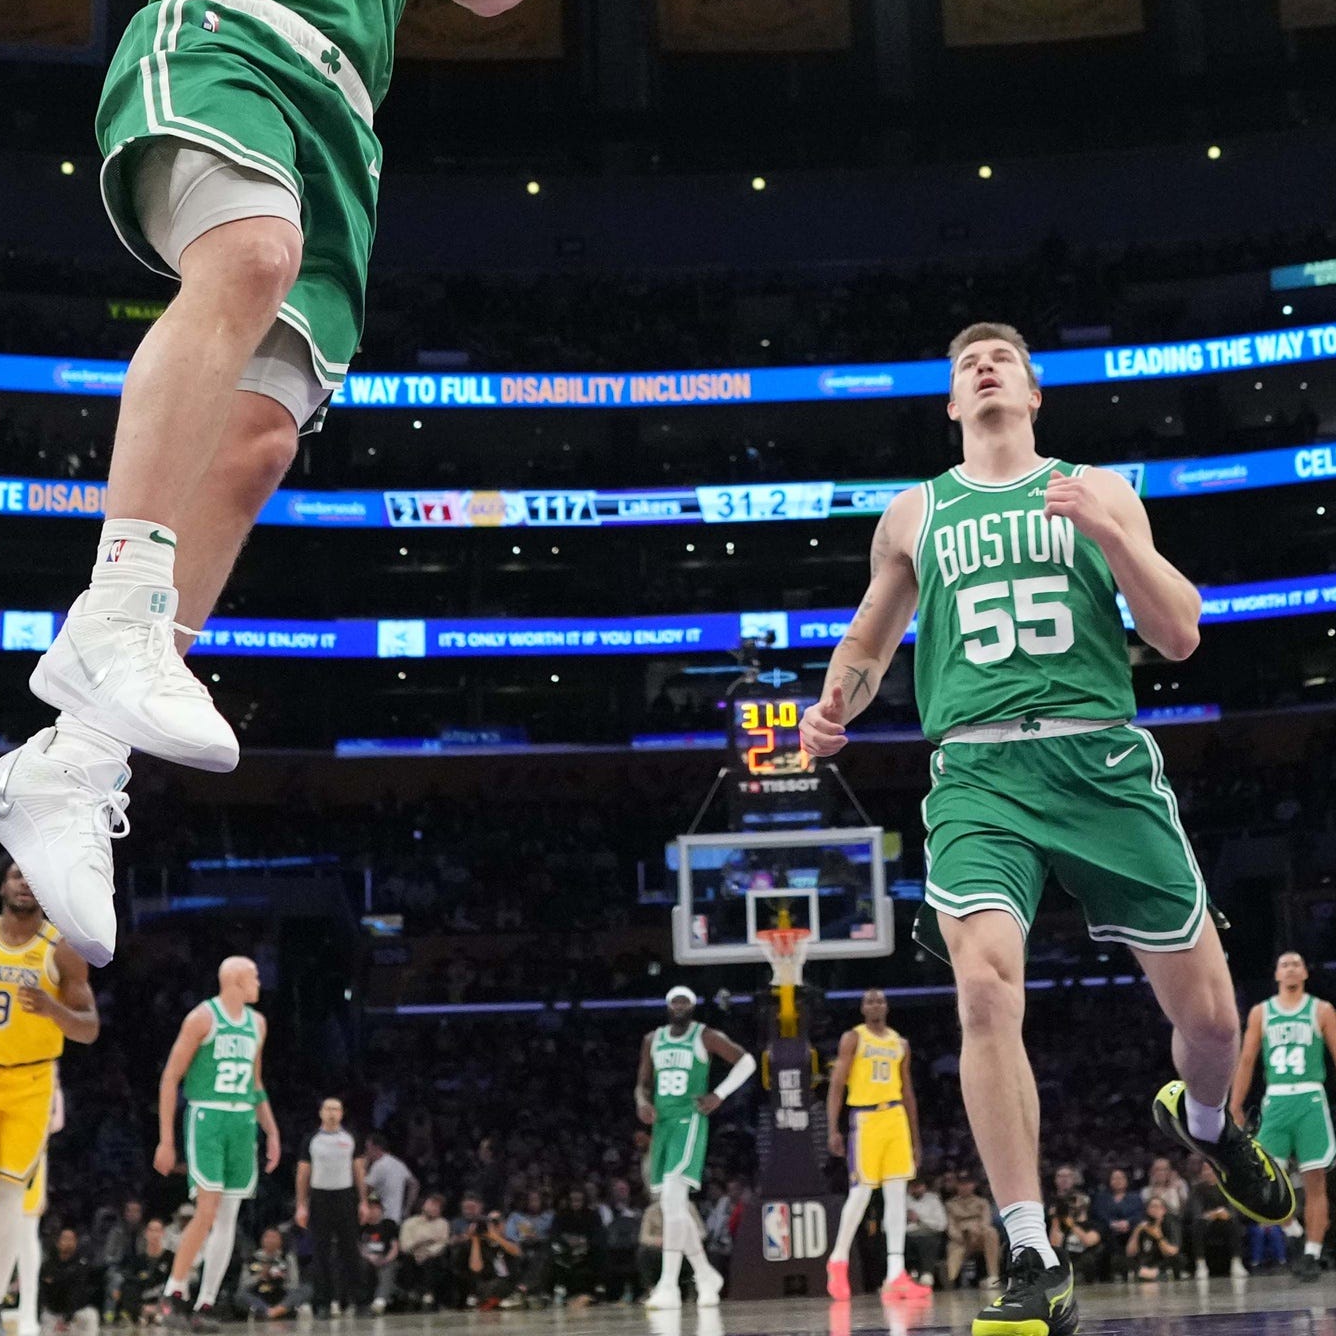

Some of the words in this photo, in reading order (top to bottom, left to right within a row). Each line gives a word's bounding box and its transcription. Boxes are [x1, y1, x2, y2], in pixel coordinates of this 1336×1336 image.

[1106, 344, 1203, 377] LEADING
[1207, 338, 1252, 368] THE
[1256, 332, 1303, 362] WAY
[351, 378, 399, 403] WAY
[405, 377, 435, 403] TO
[442, 377, 495, 403] FULL
[501, 377, 624, 403] DISABILITY
[631, 373, 751, 402] INCLUSION
[28, 484, 106, 513] DISABI
[529, 495, 587, 522] 117
[716, 490, 787, 519] 31.2
[933, 509, 1075, 588] BOSTON
[1232, 593, 1286, 612] WORTH
[1288, 591, 1302, 605] IT
[1304, 589, 1319, 604] IF
[956, 574, 1075, 665] 55
[216, 632, 230, 647] IF
[233, 632, 265, 648] YOU
[268, 632, 318, 649] ENJOY
[321, 633, 335, 649] IT
[439, 632, 466, 647] IT'S
[469, 632, 506, 647] ONLY
[508, 631, 564, 647] WORTH
[566, 631, 581, 646] IT
[582, 631, 596, 646] IF
[601, 630, 631, 645] YOU
[634, 629, 685, 645] ENJOY
[687, 629, 701, 644] IT
[741, 701, 799, 730] 31.0
[762, 777, 821, 794] TISSOT
[1269, 1045, 1306, 1076] 44
[215, 1062, 254, 1094] 27
